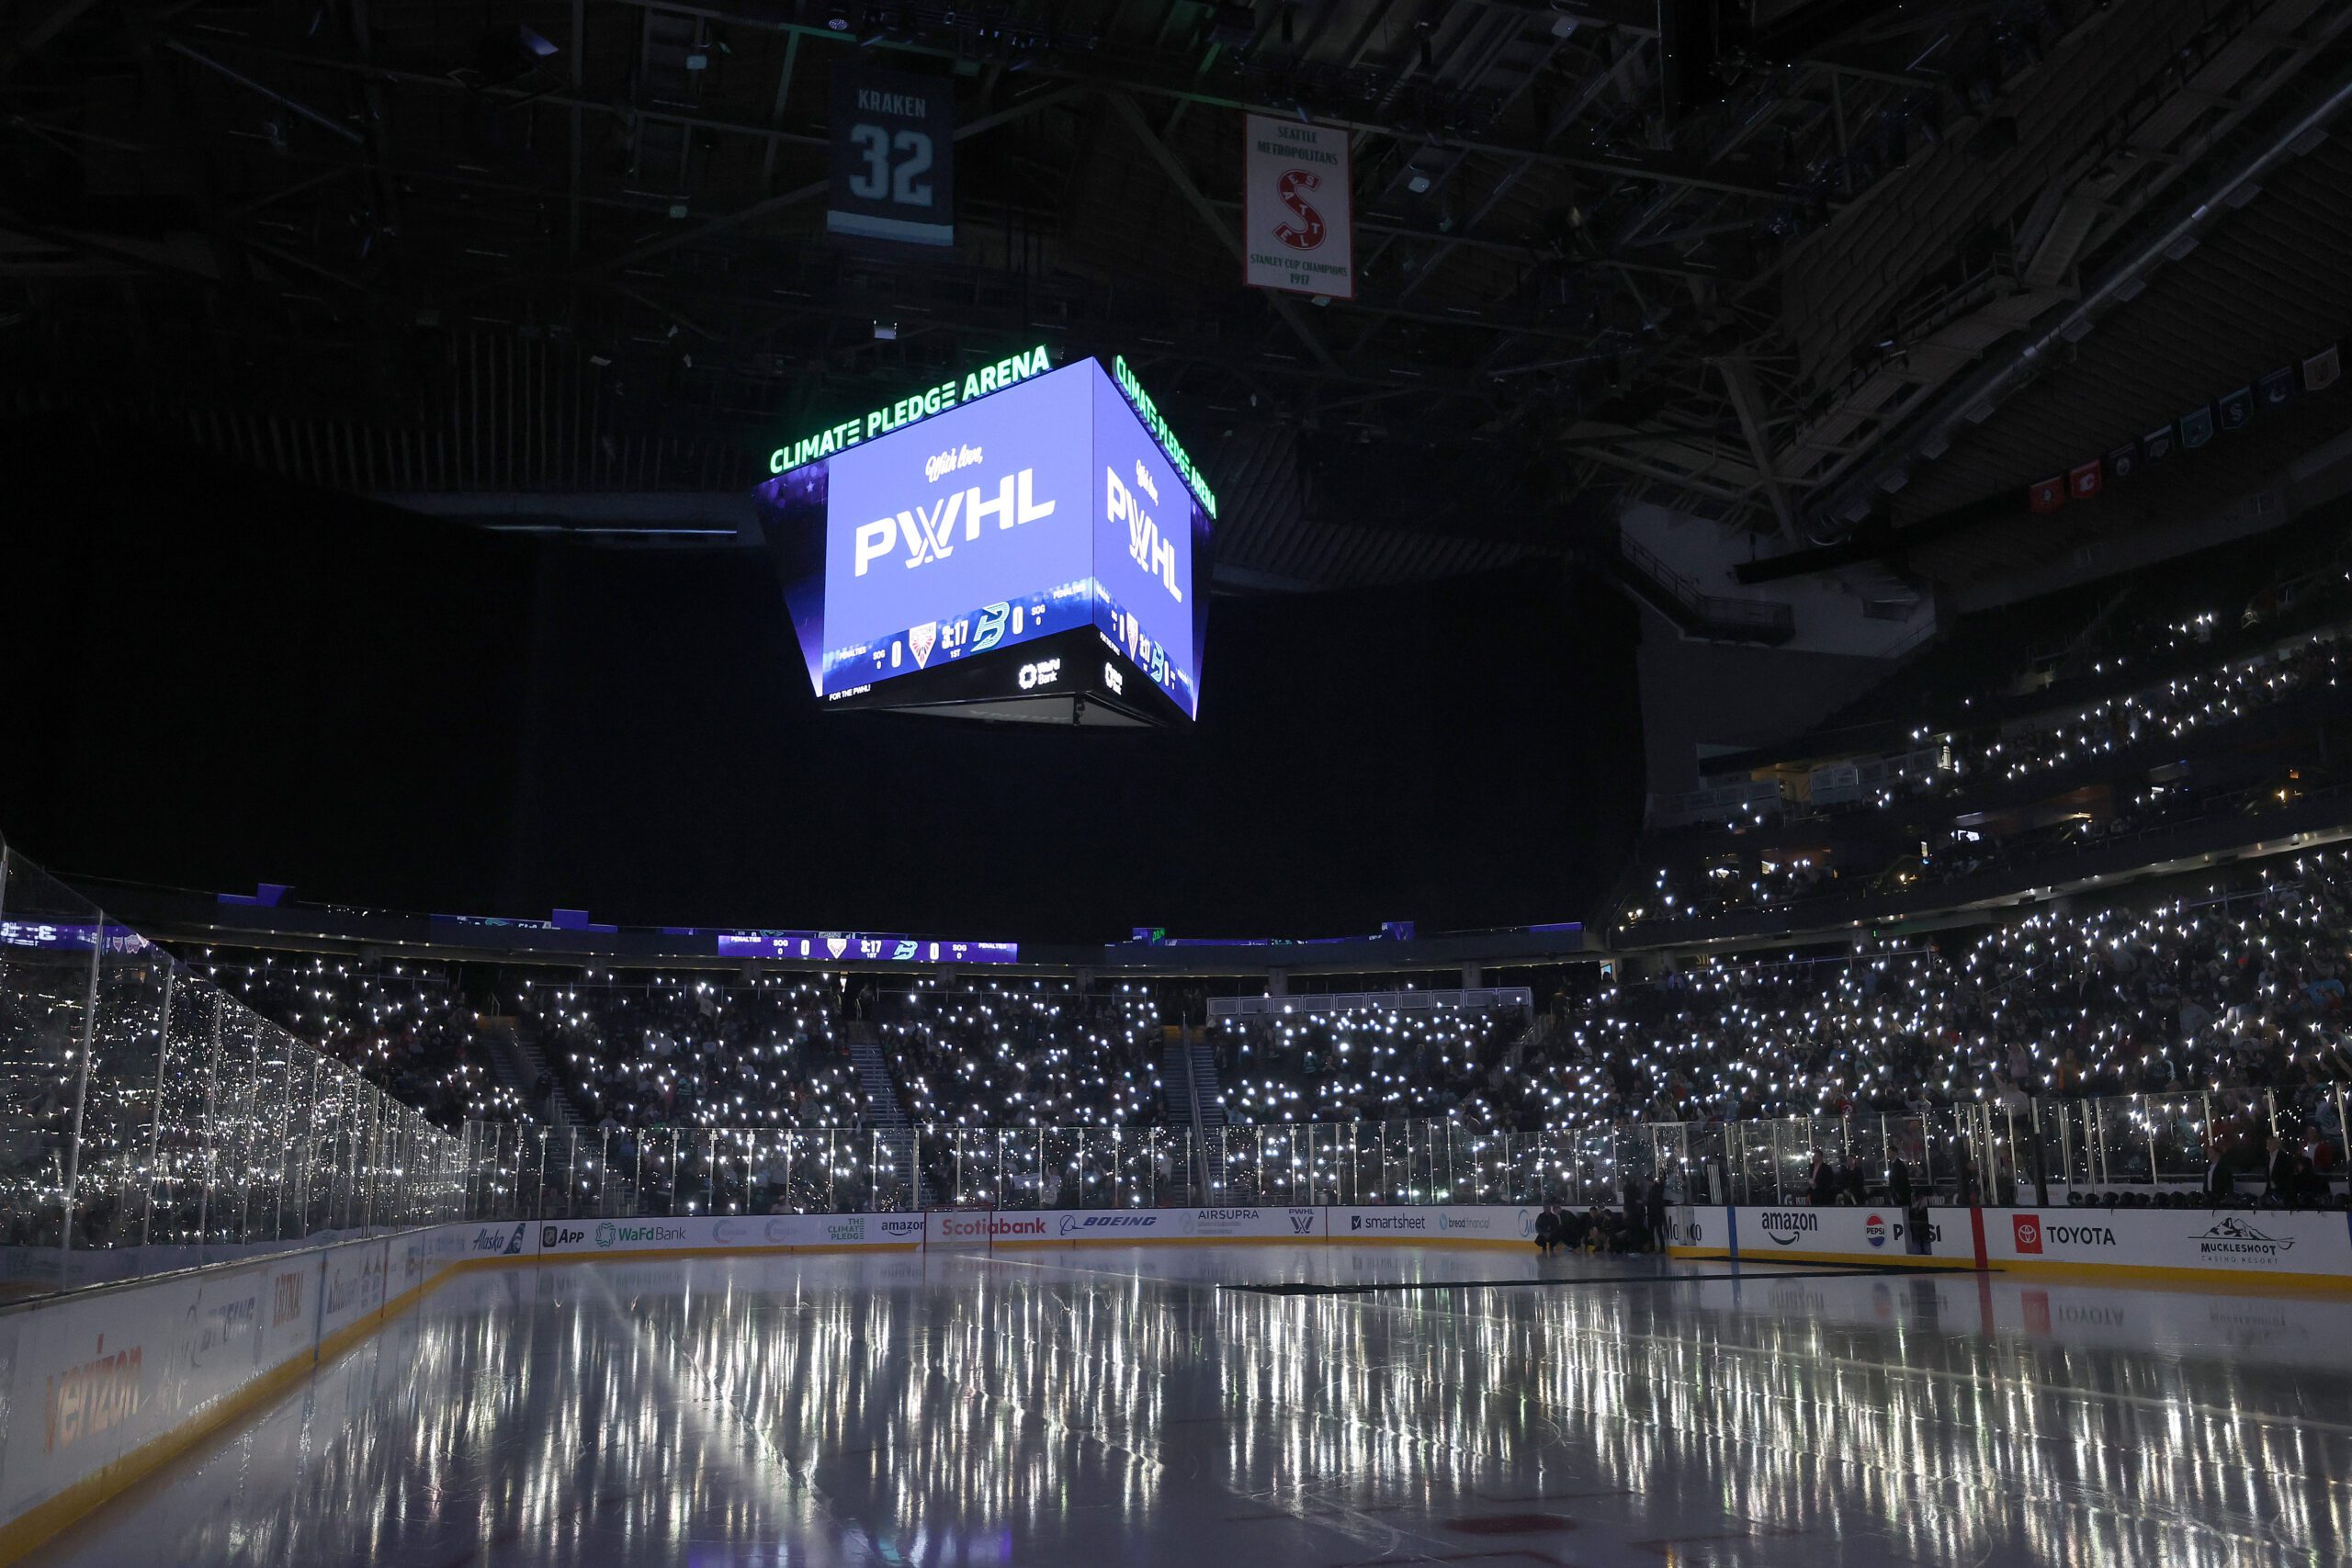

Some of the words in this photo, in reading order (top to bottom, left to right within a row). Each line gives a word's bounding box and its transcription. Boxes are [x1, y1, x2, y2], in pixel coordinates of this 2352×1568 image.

[858, 88, 926, 118] KRAKEN
[1278, 126, 1317, 143] SEATTLE
[1257, 141, 1338, 165] METROPOLITANS
[849, 123, 933, 206] 32
[1250, 254, 1283, 267] STANLEY
[1285, 260, 1301, 270] CUP
[1302, 261, 1348, 277] CHAMPIONS
[1290, 273, 1310, 286] 1917
[769, 417, 860, 473] CLIMATE
[867, 380, 956, 437] PLEDGE
[962, 344, 1049, 401] ARENA
[1115, 355, 1158, 433] CLIMATE
[1159, 415, 1190, 480] PLEDGE
[1191, 467, 1217, 520] ARENA
[854, 468, 1056, 577] PWHL
[1107, 466, 1182, 603] PWHL
[1031, 604, 1046, 616] SOG
[1012, 606, 1023, 635] 0
[838, 647, 866, 660] PENALTIES
[873, 649, 886, 660] SOG
[891, 641, 901, 668] 0
[829, 693, 841, 702] FOR
[841, 690, 853, 699] THE
[800, 940, 810, 956] 0
[930, 942, 940, 961] 0
[1083, 1216, 1157, 1226] BOEING
[1198, 1209, 1260, 1220] AIRSUPRA
[1365, 1213, 1426, 1229] smartsheet
[1448, 1217, 1465, 1228] bread
[1762, 1212, 1817, 1231] amazon
[619, 1227, 654, 1241] WaFd
[656, 1226, 686, 1240] Bank
[942, 1217, 1046, 1235] Scotiabank
[1866, 1227, 1884, 1235] PEPSI
[1894, 1224, 1941, 1243] PSI
[472, 1227, 504, 1251] Alaska
[2046, 1226, 2116, 1246] TOYOTA
[2200, 1243, 2276, 1256] MUCKLESHOOT
[2201, 1255, 2236, 1263] CASINO
[2242, 1257, 2278, 1265] RESORT
